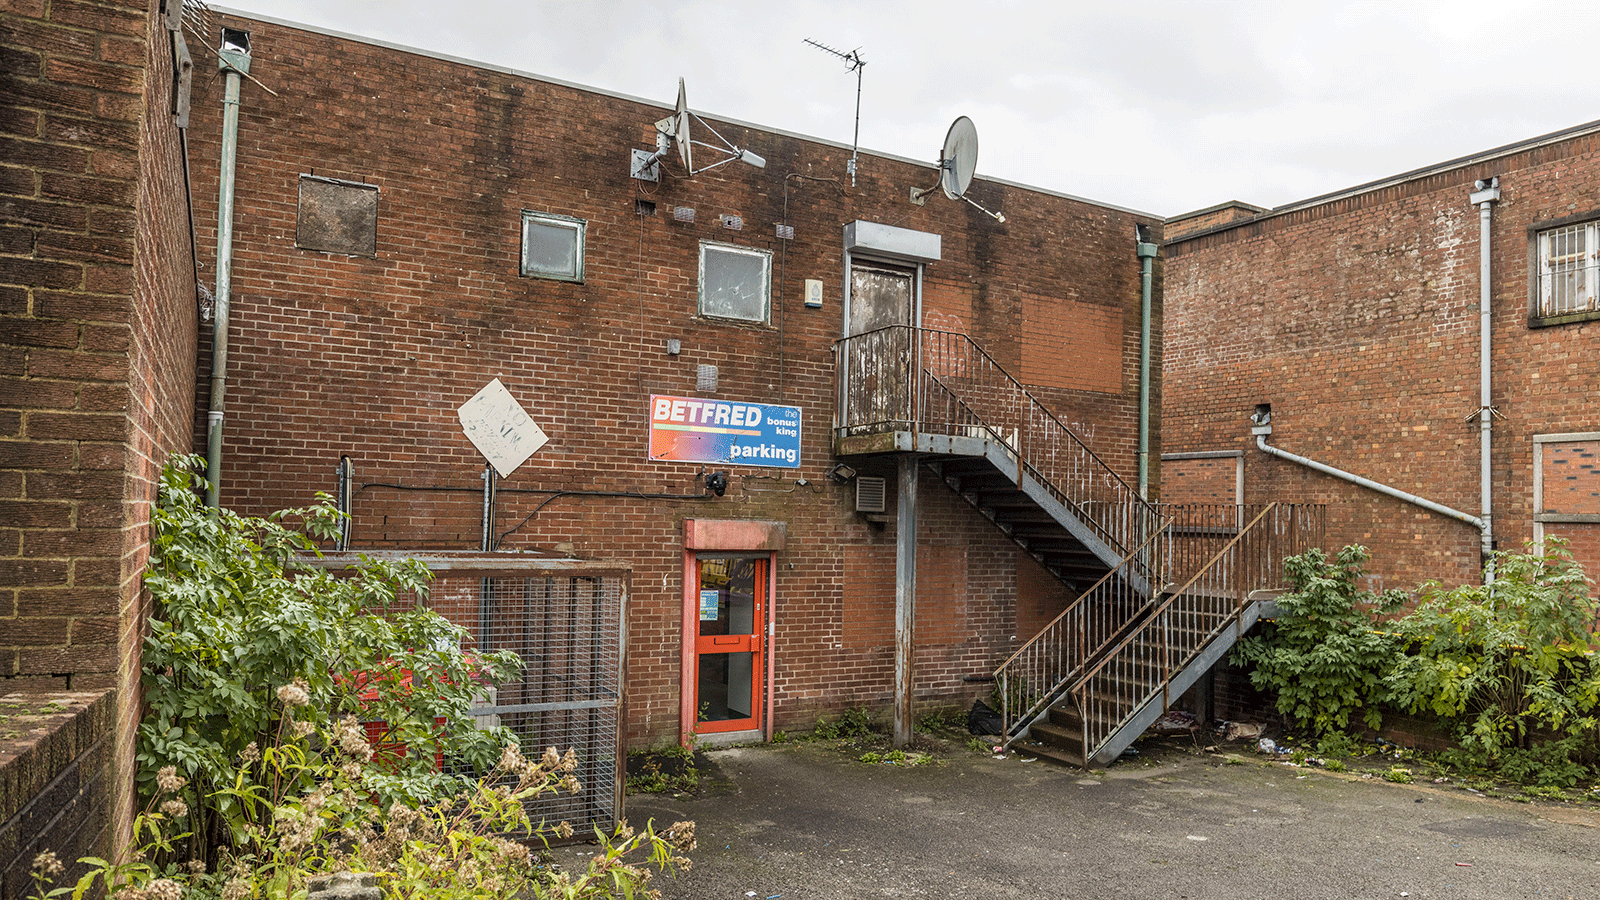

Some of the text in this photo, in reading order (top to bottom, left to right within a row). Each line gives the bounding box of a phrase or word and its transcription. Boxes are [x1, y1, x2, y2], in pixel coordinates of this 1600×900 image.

[653, 399, 762, 427] BETFRED
[784, 409, 798, 419] the
[766, 416, 797, 427] bonus
[776, 426, 797, 437] king
[730, 443, 796, 463] parking
